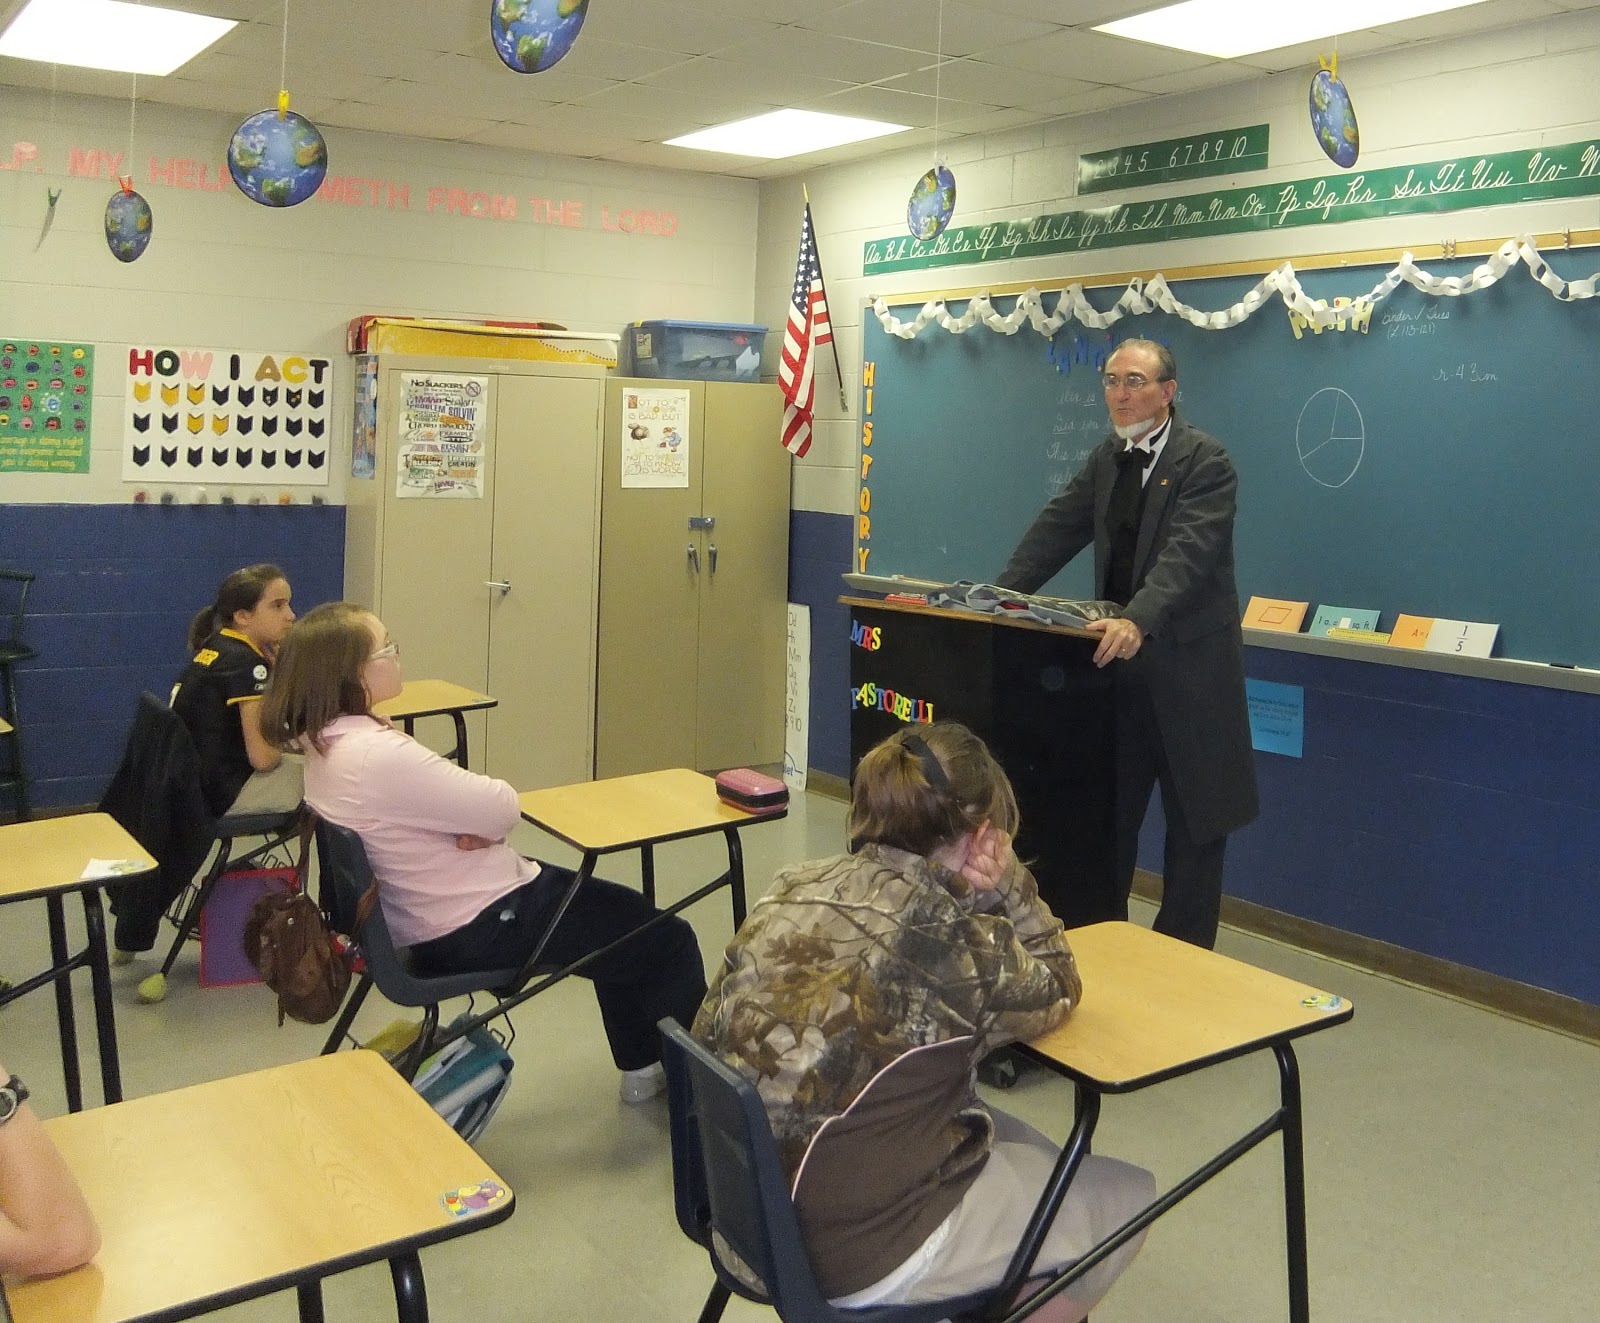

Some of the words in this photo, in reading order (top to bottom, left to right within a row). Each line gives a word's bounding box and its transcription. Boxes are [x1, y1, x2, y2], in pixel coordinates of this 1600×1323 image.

[1124, 154, 1133, 174] 4
[1138, 151, 1150, 172] 5
[1169, 147, 1180, 168] 6
[1184, 145, 1193, 166] 7
[1199, 142, 1209, 163] 8
[1215, 139, 1224, 161] 9
[1230, 136, 1247, 158] 10
[69, 148, 124, 181] MY
[428, 187, 517, 221] FROM
[530, 197, 585, 228] THE
[601, 206, 679, 237] LORD
[865, 243, 882, 264] Aa
[884, 238, 907, 262] Bb
[952, 230, 971, 252] Ee
[974, 226, 998, 259] Ff
[1132, 202, 1167, 230] Ll
[1172, 203, 1204, 226] Mm
[1208, 198, 1238, 221] Nn
[1241, 193, 1266, 216] Oo
[1275, 185, 1301, 225] Pp
[1305, 180, 1339, 220] Qq
[1343, 175, 1377, 204] Rr
[1391, 169, 1426, 199] Ss
[1430, 163, 1466, 194] Tt
[1471, 159, 1514, 189] Uu
[1528, 152, 1568, 183] Vv
[129, 349, 213, 380] HOW
[230, 354, 240, 381] I
[255, 355, 329, 384] ACT
[858, 361, 875, 573] HISTORY
[850, 619, 881, 651] MRS
[851, 682, 935, 724] PASTORELLI
